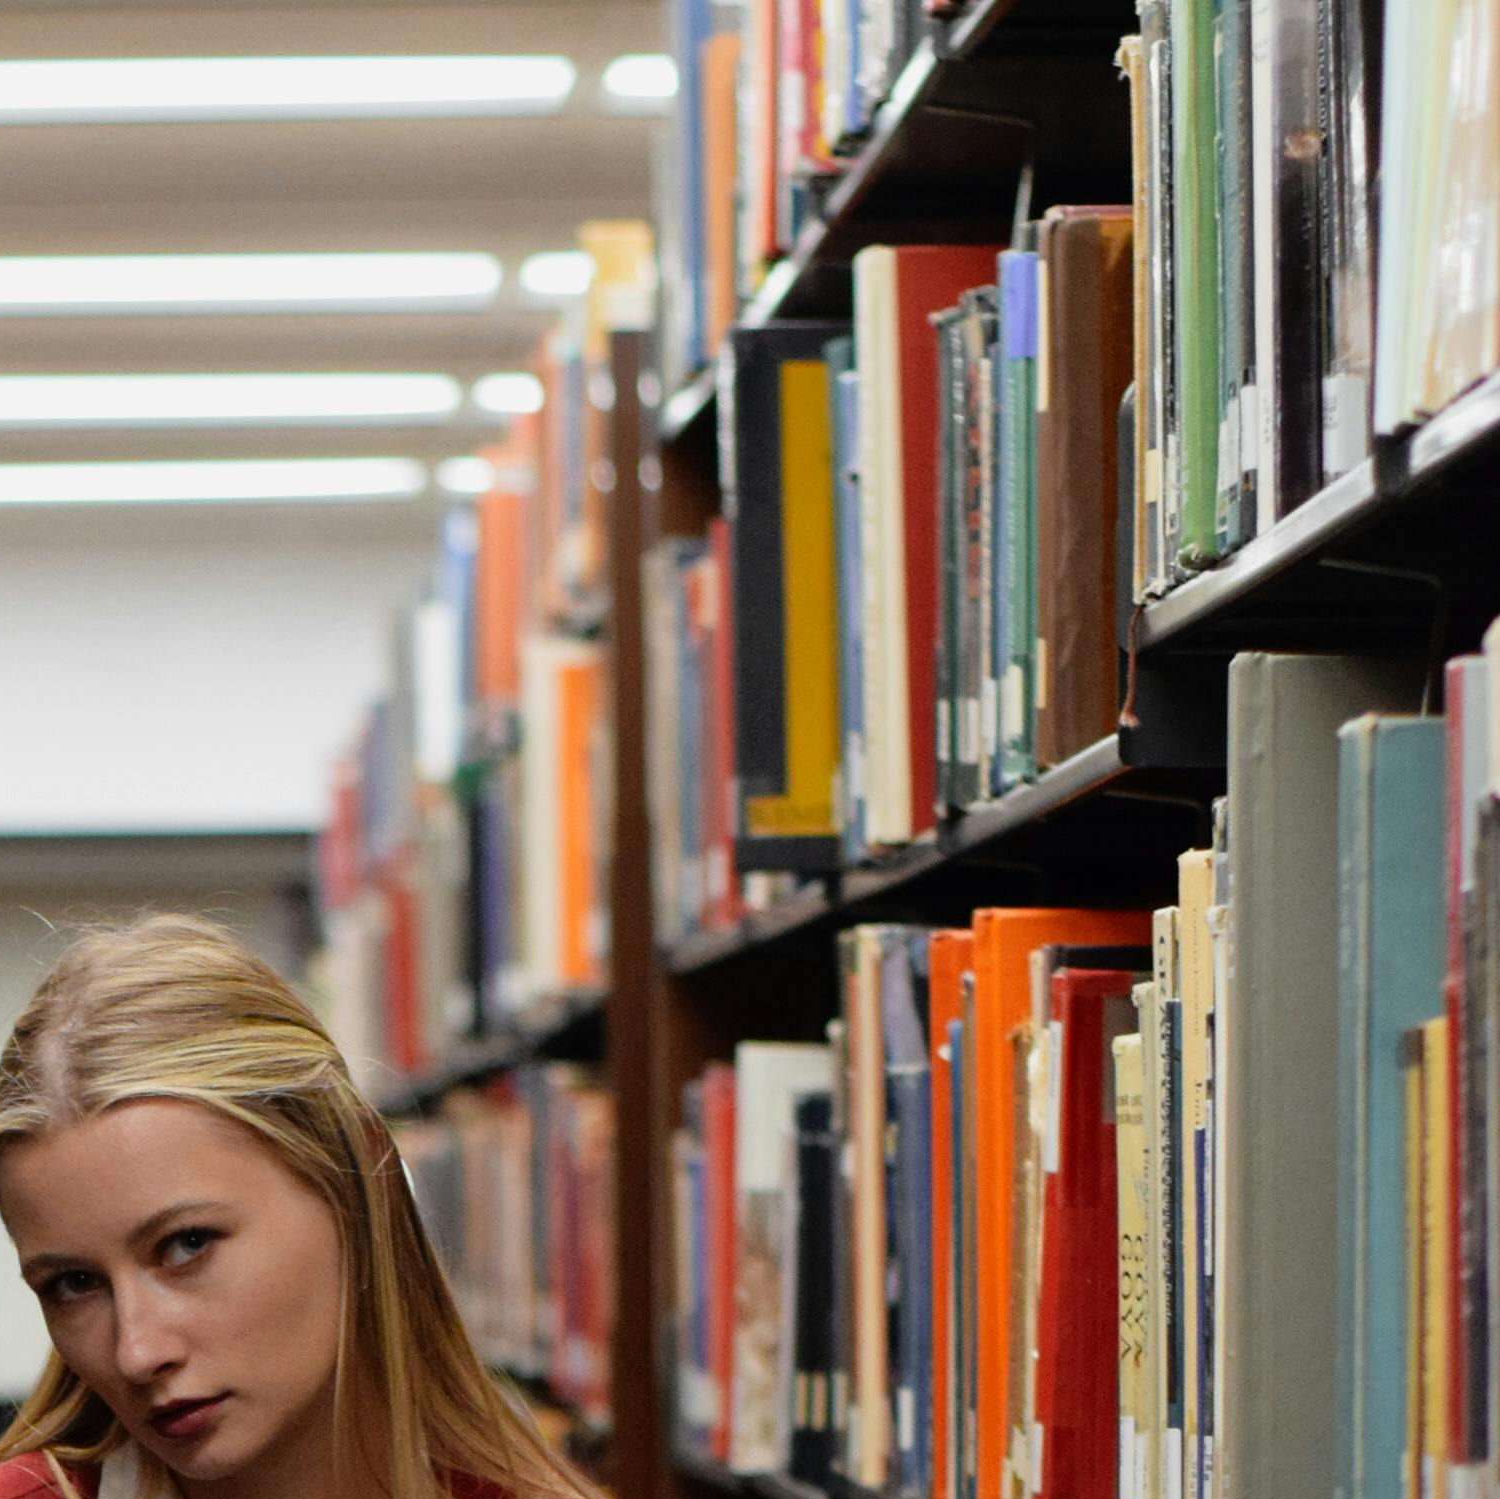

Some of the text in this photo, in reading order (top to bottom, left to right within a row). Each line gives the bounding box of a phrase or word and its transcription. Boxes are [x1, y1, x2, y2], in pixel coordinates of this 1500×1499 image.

[1318, 0, 1327, 139] RANCISCO GOYA
[1121, 1233, 1133, 1359] GOYA
[1133, 1234, 1144, 1362] GOYA
